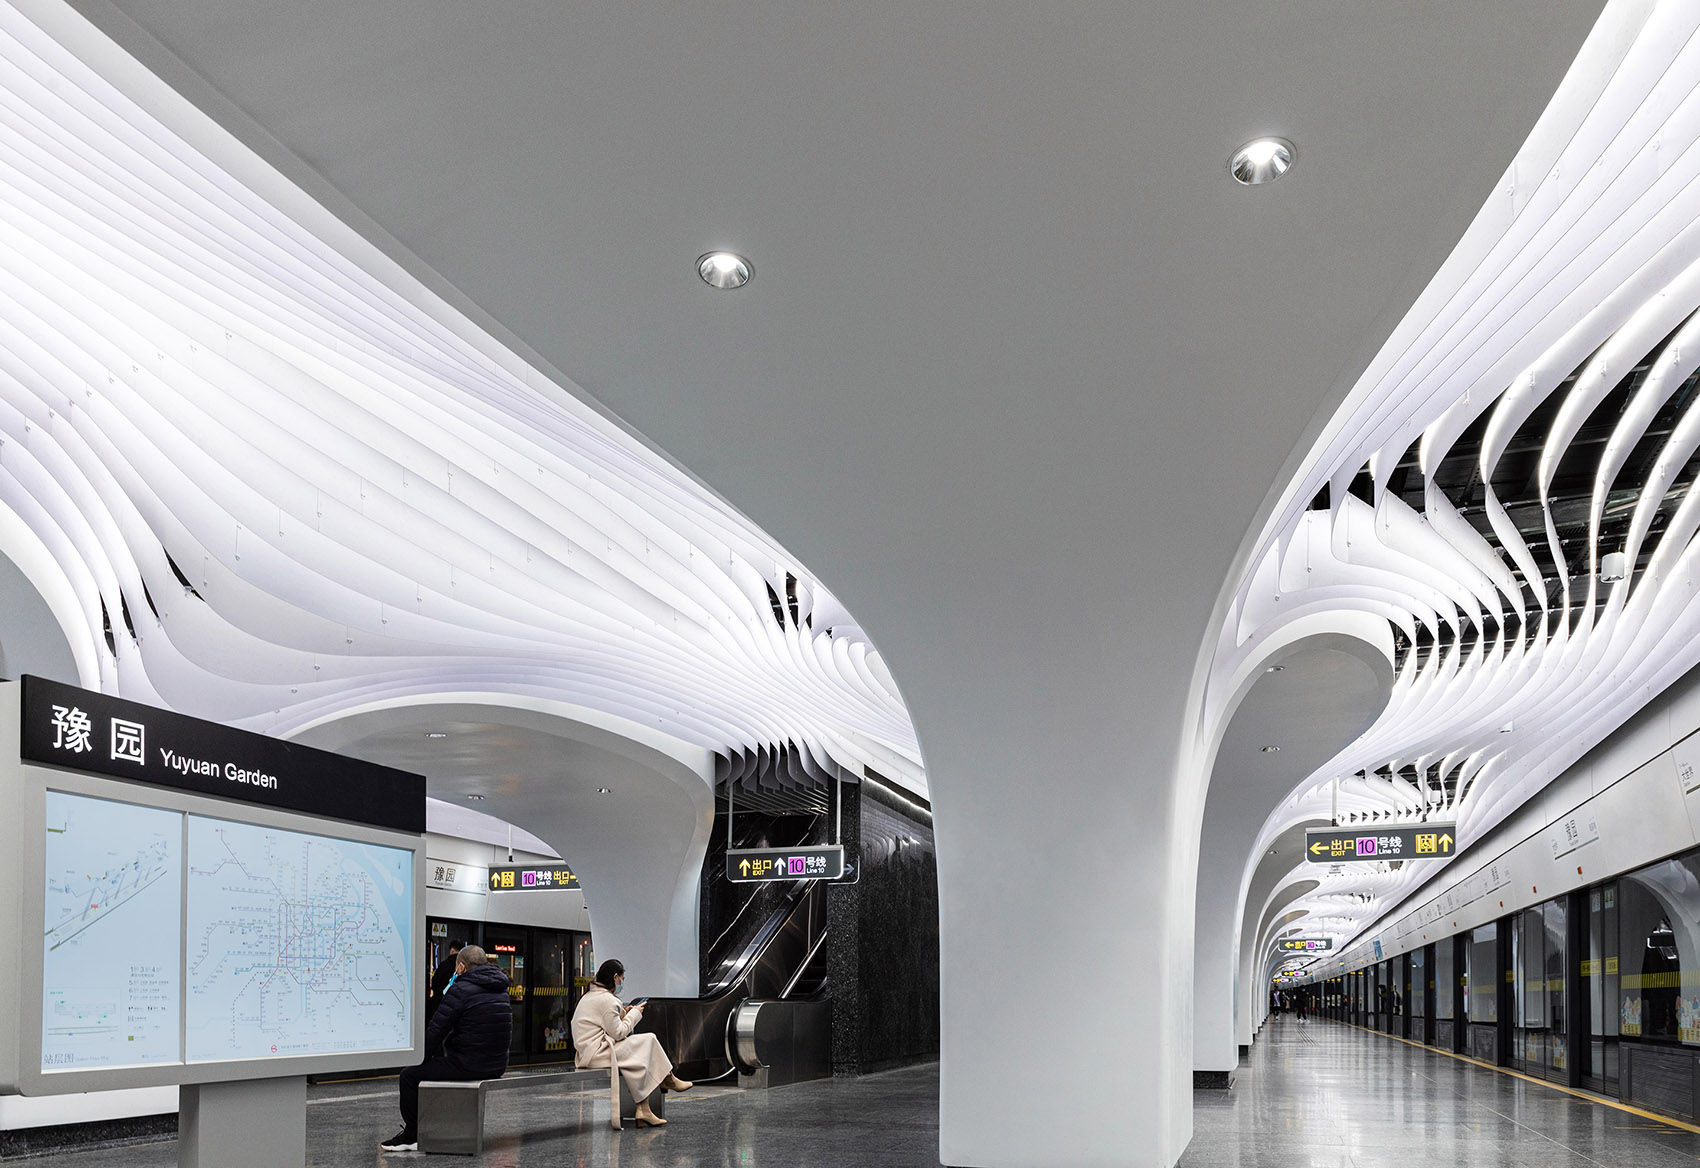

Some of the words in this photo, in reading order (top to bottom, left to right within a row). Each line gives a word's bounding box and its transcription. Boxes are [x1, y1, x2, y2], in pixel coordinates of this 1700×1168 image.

[51, 704, 145, 766] 豫园
[160, 748, 220, 777] Yuyuan
[224, 763, 278, 790] Garden
[1331, 839, 1355, 851] 出口
[1358, 839, 1375, 854] 10
[1377, 836, 1402, 849] 号线
[752, 859, 772, 870] 出口
[789, 859, 804, 873] 10
[806, 856, 827, 868] 号线
[523, 873, 535, 885] 10
[553, 870, 570, 880] 出口
